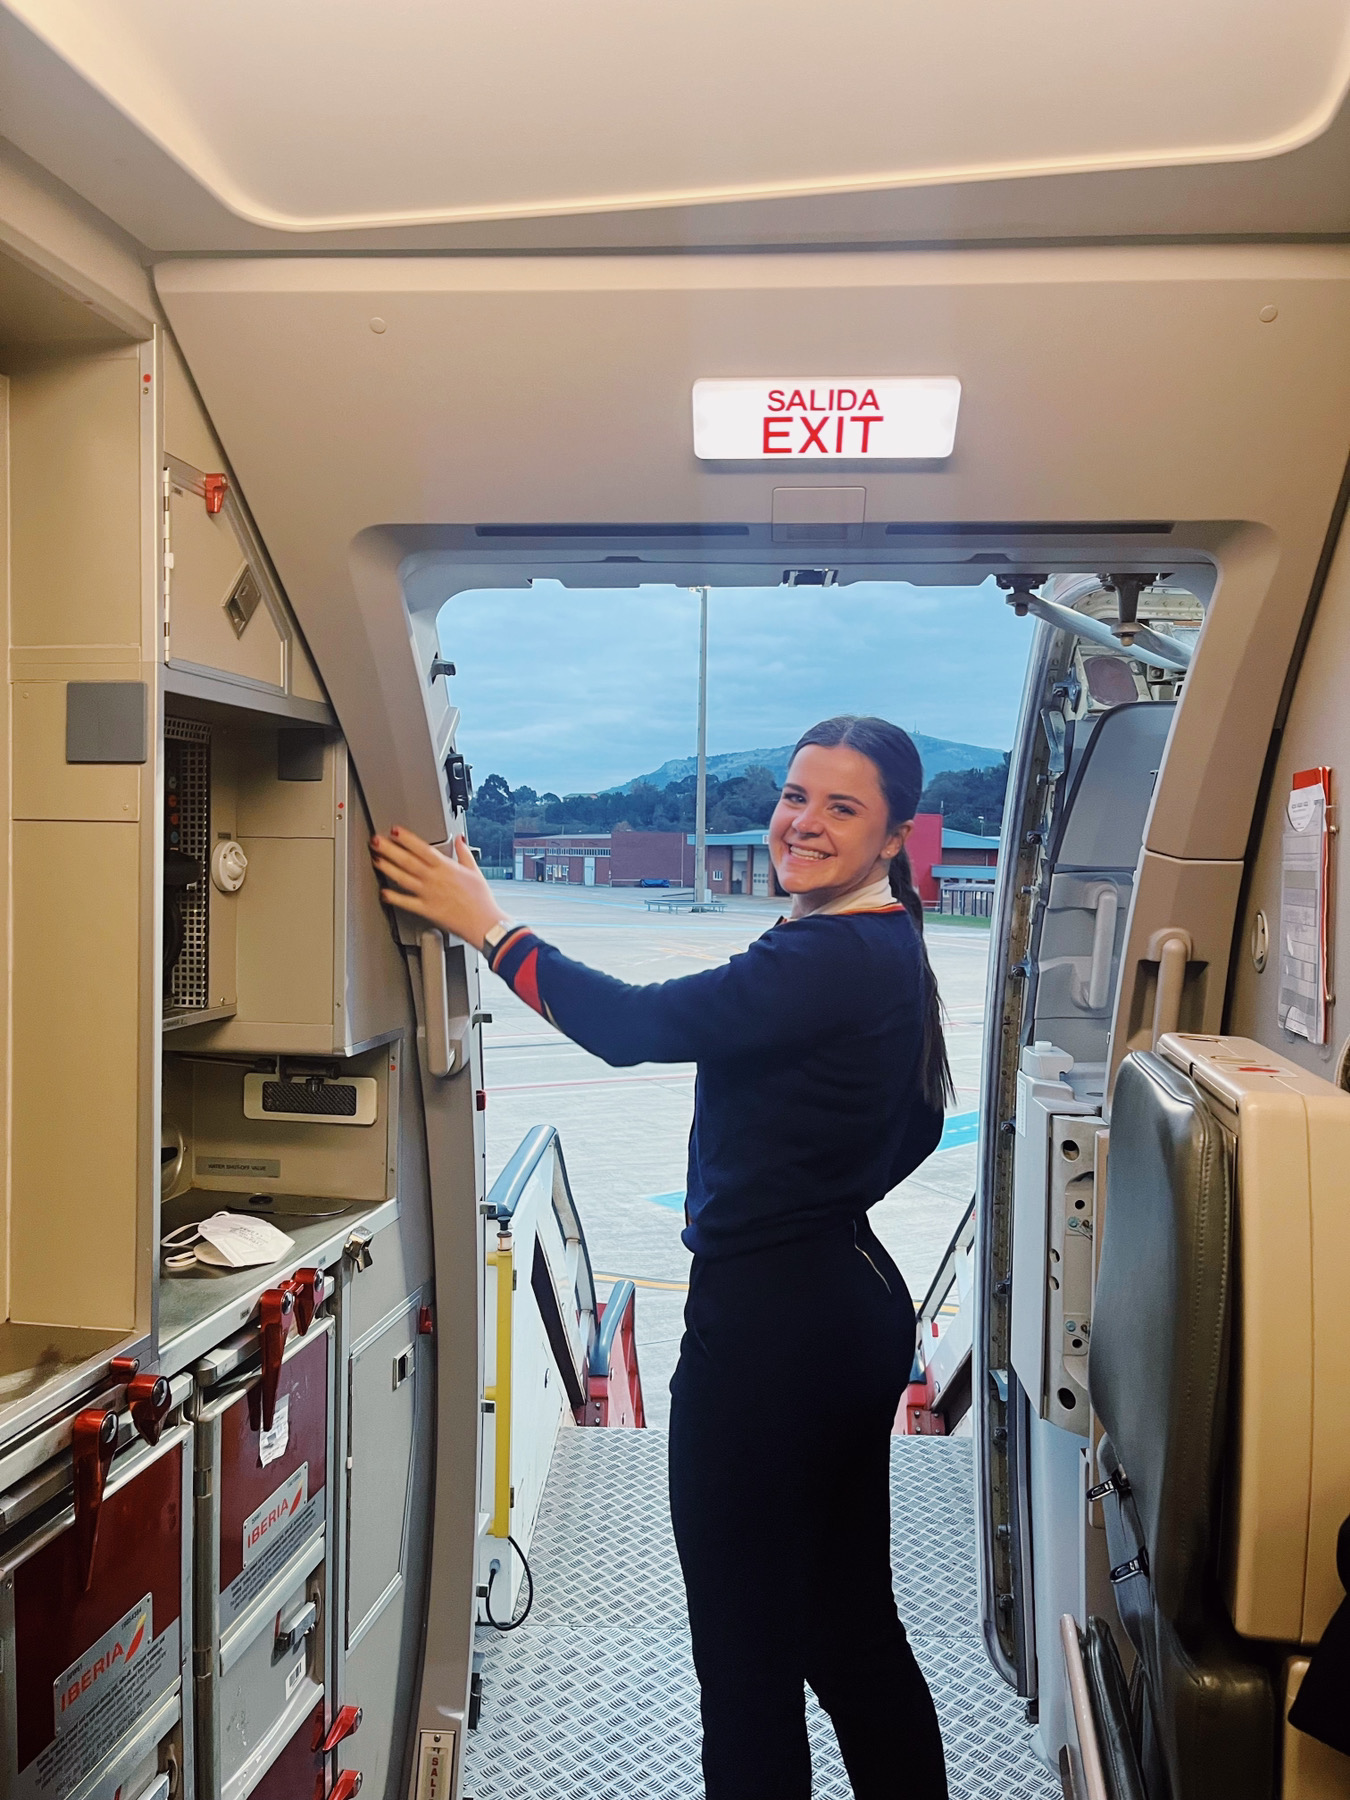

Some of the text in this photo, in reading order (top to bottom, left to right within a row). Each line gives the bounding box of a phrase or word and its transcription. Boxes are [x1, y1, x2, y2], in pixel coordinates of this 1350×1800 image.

[767, 389, 880, 411] SALIDA
[763, 416, 884, 453] EXIT
[247, 1497, 289, 1549] IBERIA
[60, 1641, 125, 1712] IBERIA
[429, 1757, 439, 1800] SALI
